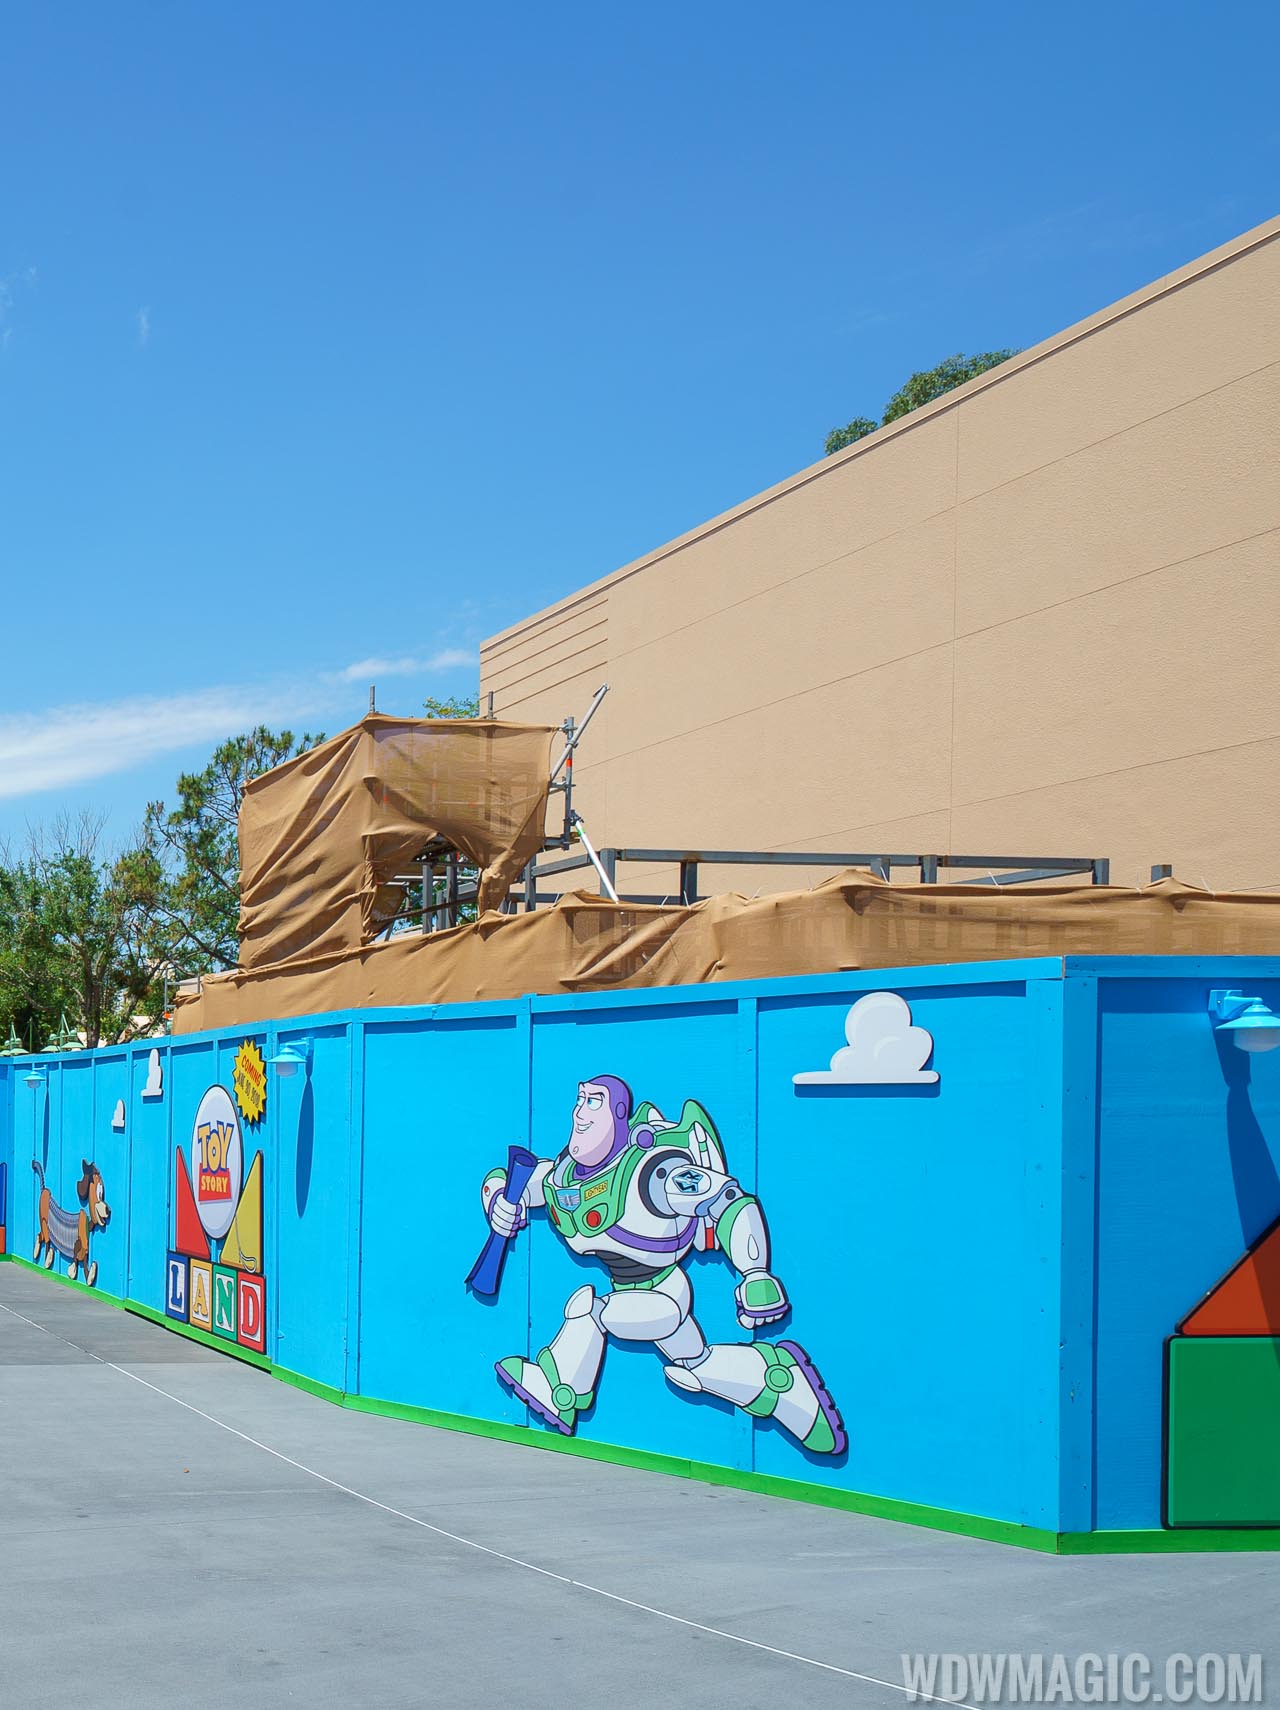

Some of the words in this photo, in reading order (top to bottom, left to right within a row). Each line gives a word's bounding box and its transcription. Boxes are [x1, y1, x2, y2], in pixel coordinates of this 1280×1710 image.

[241, 1054, 262, 1087] COMING
[198, 1120, 235, 1174] TOY
[200, 1174, 228, 1193] STORY
[169, 1262, 261, 1338] LAND
